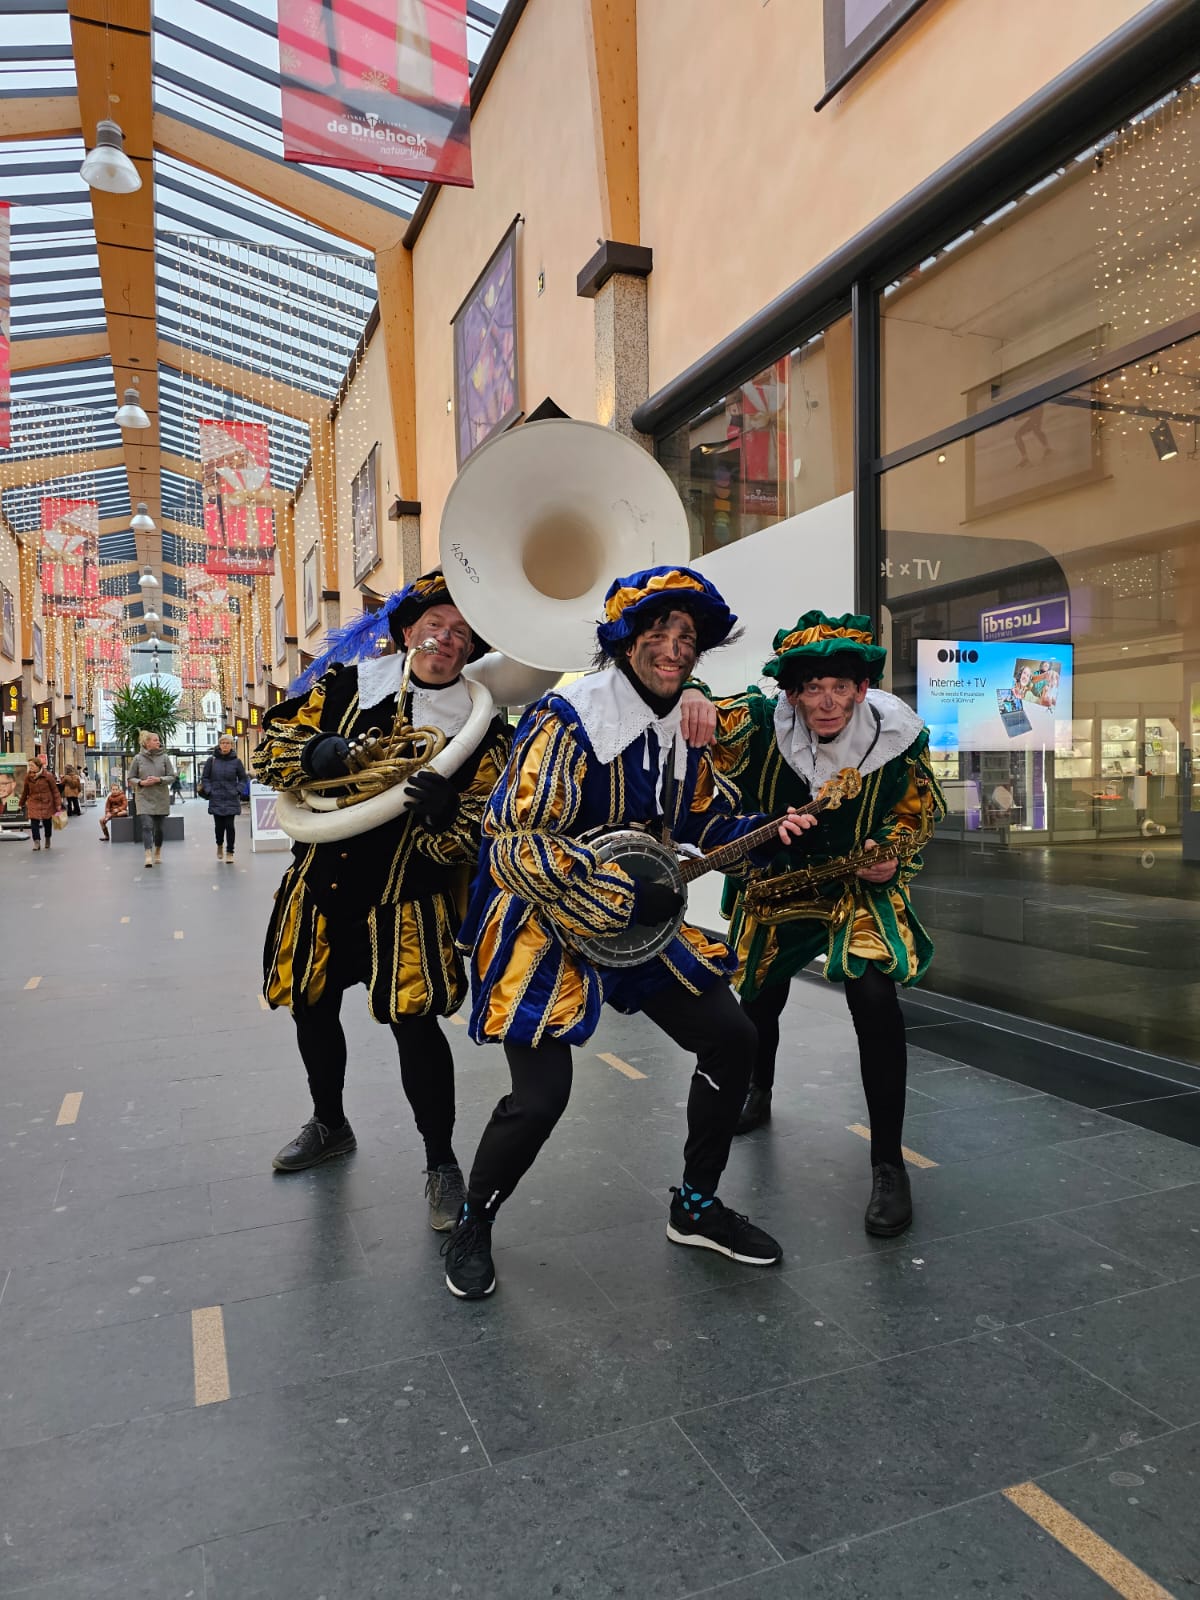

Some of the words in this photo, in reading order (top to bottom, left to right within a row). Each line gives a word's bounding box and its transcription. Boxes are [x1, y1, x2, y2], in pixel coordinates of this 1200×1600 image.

[327, 120, 348, 134] de
[351, 122, 427, 146] Driehoek
[912, 558, 941, 581] TV
[929, 677, 964, 688] Internet
[973, 677, 987, 688] TV
